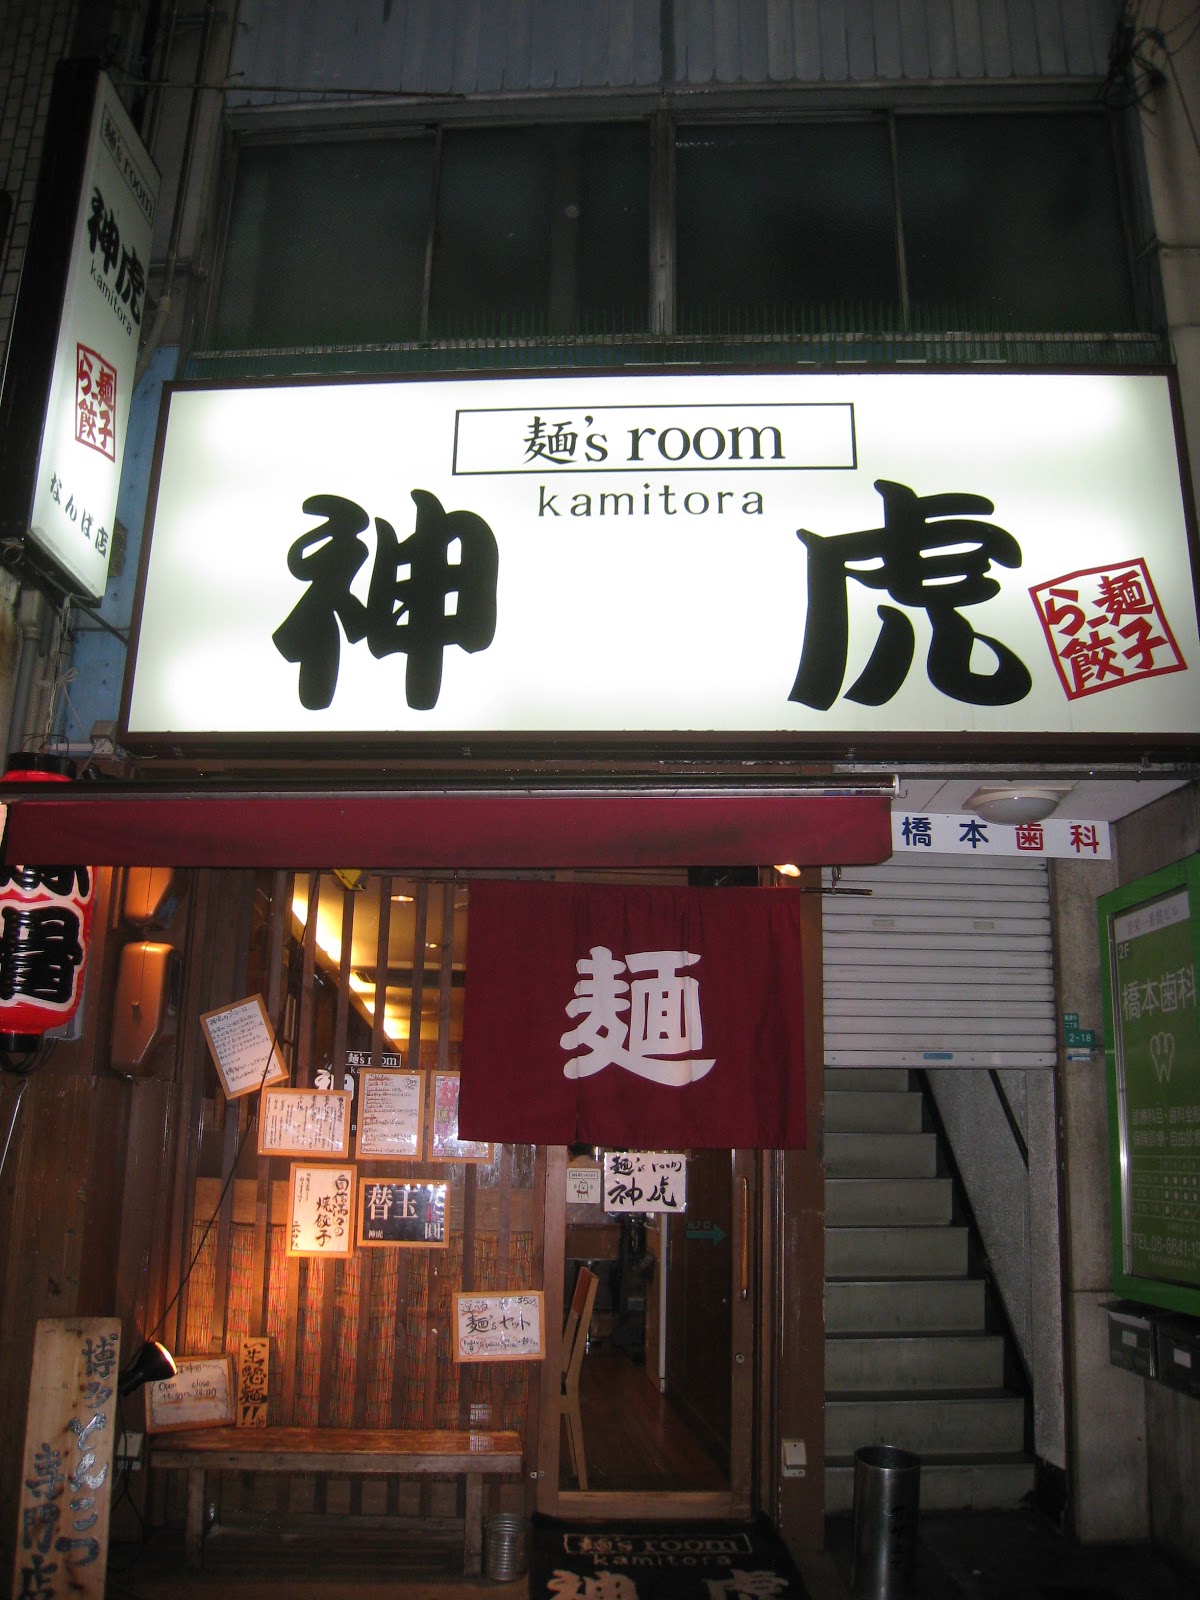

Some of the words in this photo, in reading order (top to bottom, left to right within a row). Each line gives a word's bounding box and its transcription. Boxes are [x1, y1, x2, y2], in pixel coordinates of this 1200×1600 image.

[87, 186, 146, 325] 神虎
[90, 260, 132, 336] kamitora
[78, 398, 113, 450] 餃子
[626, 425, 786, 461] room
[50, 472, 108, 558] なんば店
[538, 483, 764, 517] kamitora
[1059, 616, 1170, 692] 餃子
[901, 815, 1100, 855] 橋本歯科
[1119, 943, 1130, 959] 2F
[1122, 964, 1197, 1021] 橋本歯科
[559, 945, 717, 1087] 麺
[1069, 1033, 1092, 1043] 2-18
[367, 1186, 419, 1220] 替玉
[608, 1176, 678, 1206] 神虎
[368, 1229, 384, 1239] 神虎
[55, 1333, 119, 1568] 博多とんこつ
[592, 1553, 733, 1567] kamitora
